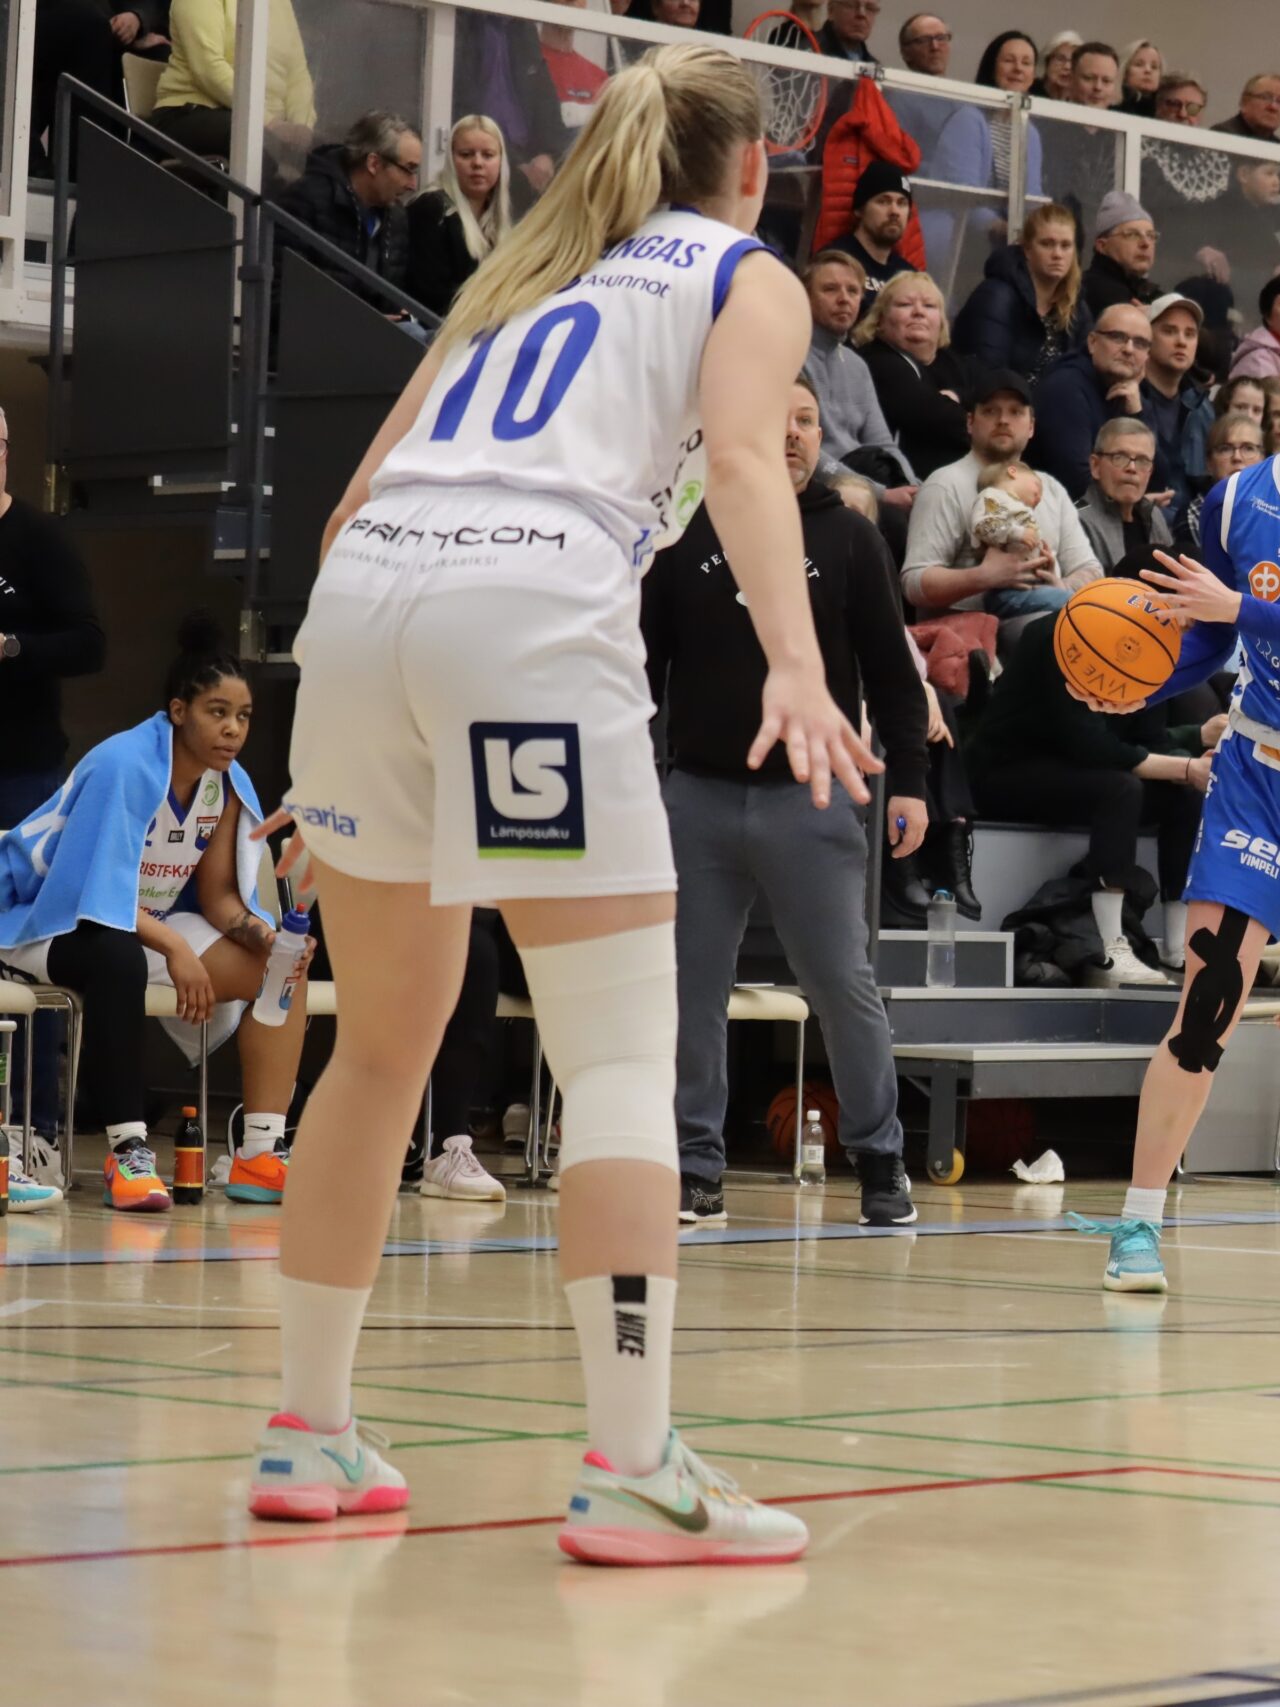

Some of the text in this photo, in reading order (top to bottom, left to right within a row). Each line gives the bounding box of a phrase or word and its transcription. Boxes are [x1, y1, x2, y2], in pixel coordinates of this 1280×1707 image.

[429, 300, 601, 441] 10
[1240, 852, 1279, 880] VIMPELI
[616, 1309, 646, 1358] NIKE
